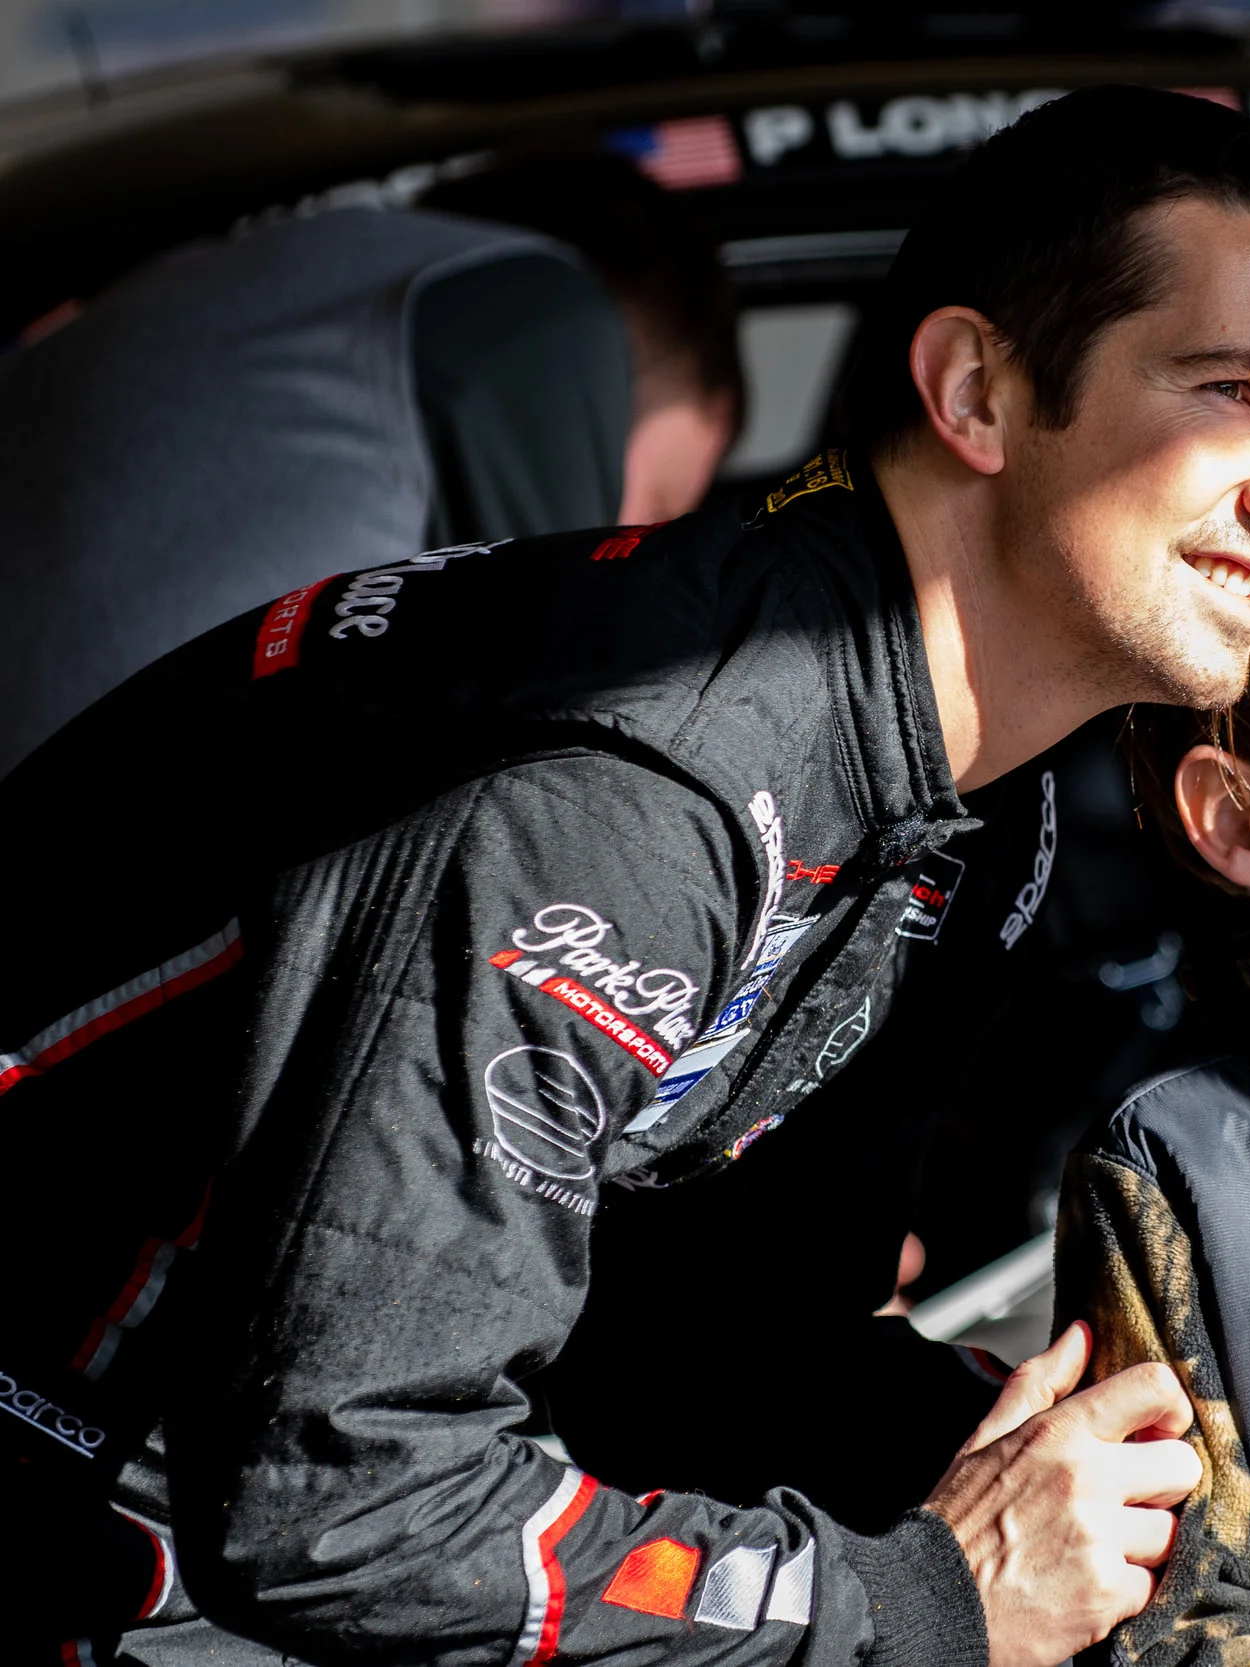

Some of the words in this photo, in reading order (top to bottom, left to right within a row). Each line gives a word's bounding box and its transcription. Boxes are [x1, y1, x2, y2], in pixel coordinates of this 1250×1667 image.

[743, 104, 813, 166] P
[825, 89, 1076, 158] LON
[1000, 771, 1057, 950] sparco
[0, 1371, 107, 1449] parco
